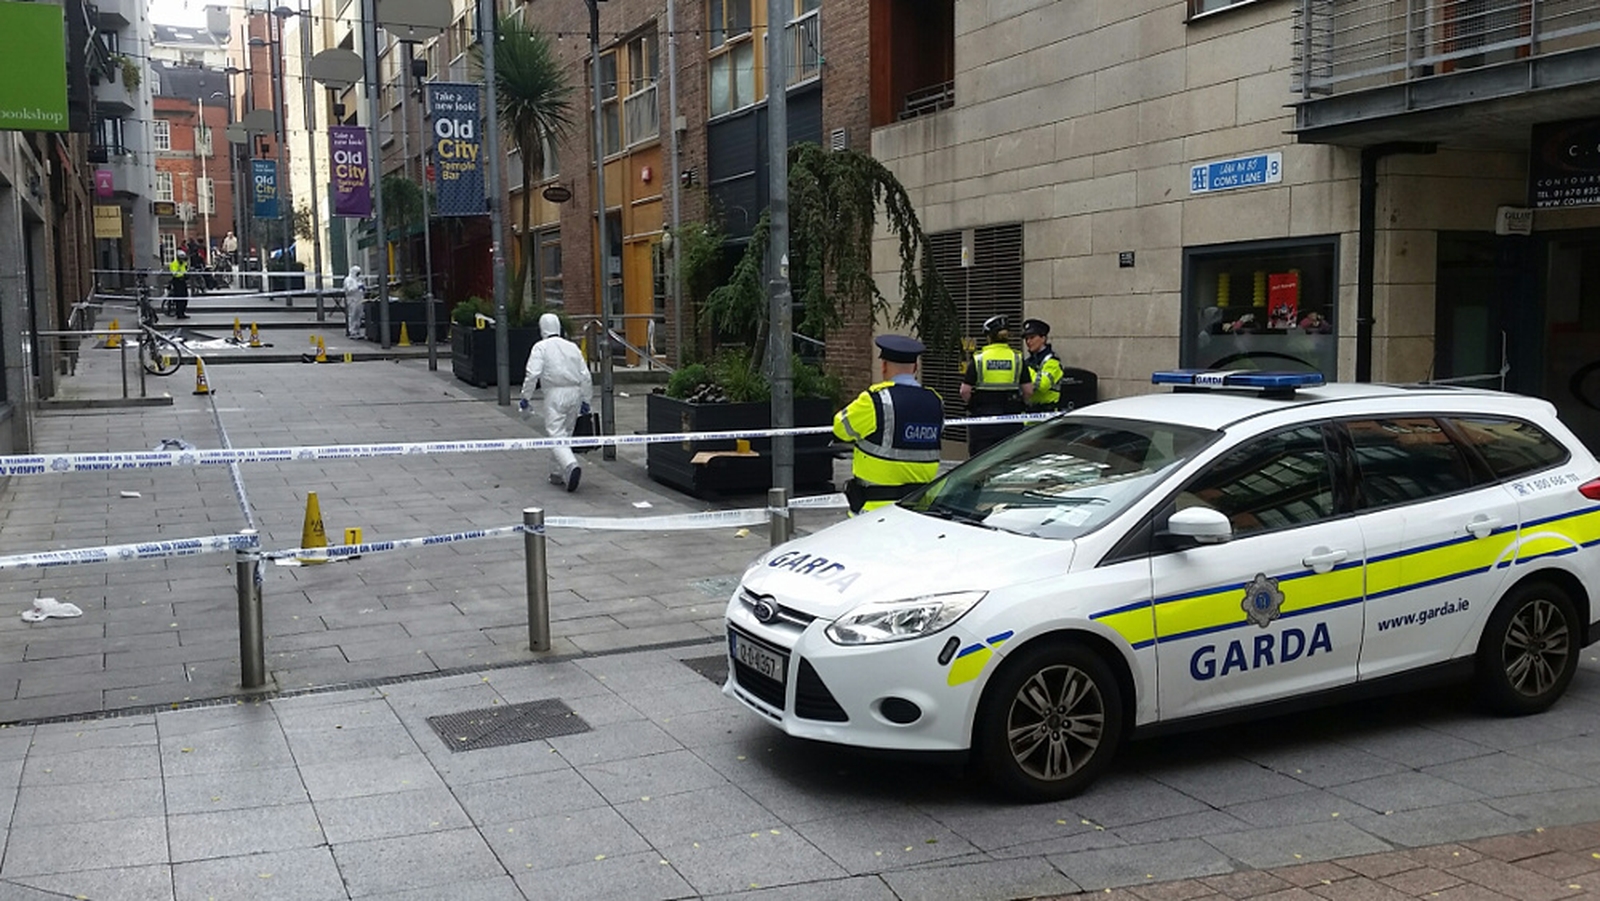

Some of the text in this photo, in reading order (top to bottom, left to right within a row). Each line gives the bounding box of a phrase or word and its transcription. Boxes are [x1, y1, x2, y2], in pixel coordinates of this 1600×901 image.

[434, 91, 455, 101] Take
[455, 102, 477, 111] look!
[435, 118, 474, 139] Old
[334, 150, 362, 164] Old
[438, 139, 479, 161] City
[336, 164, 366, 181] City
[440, 161, 476, 171] Temple
[255, 175, 274, 185] Old
[442, 171, 460, 180] Bar
[1241, 172, 1261, 183] LANE
[1196, 375, 1222, 385] GARDA
[905, 425, 938, 440] GARDA
[768, 551, 862, 593] GARDA
[1378, 598, 1470, 631] www.garda.ie
[1190, 622, 1333, 681] GARDA
